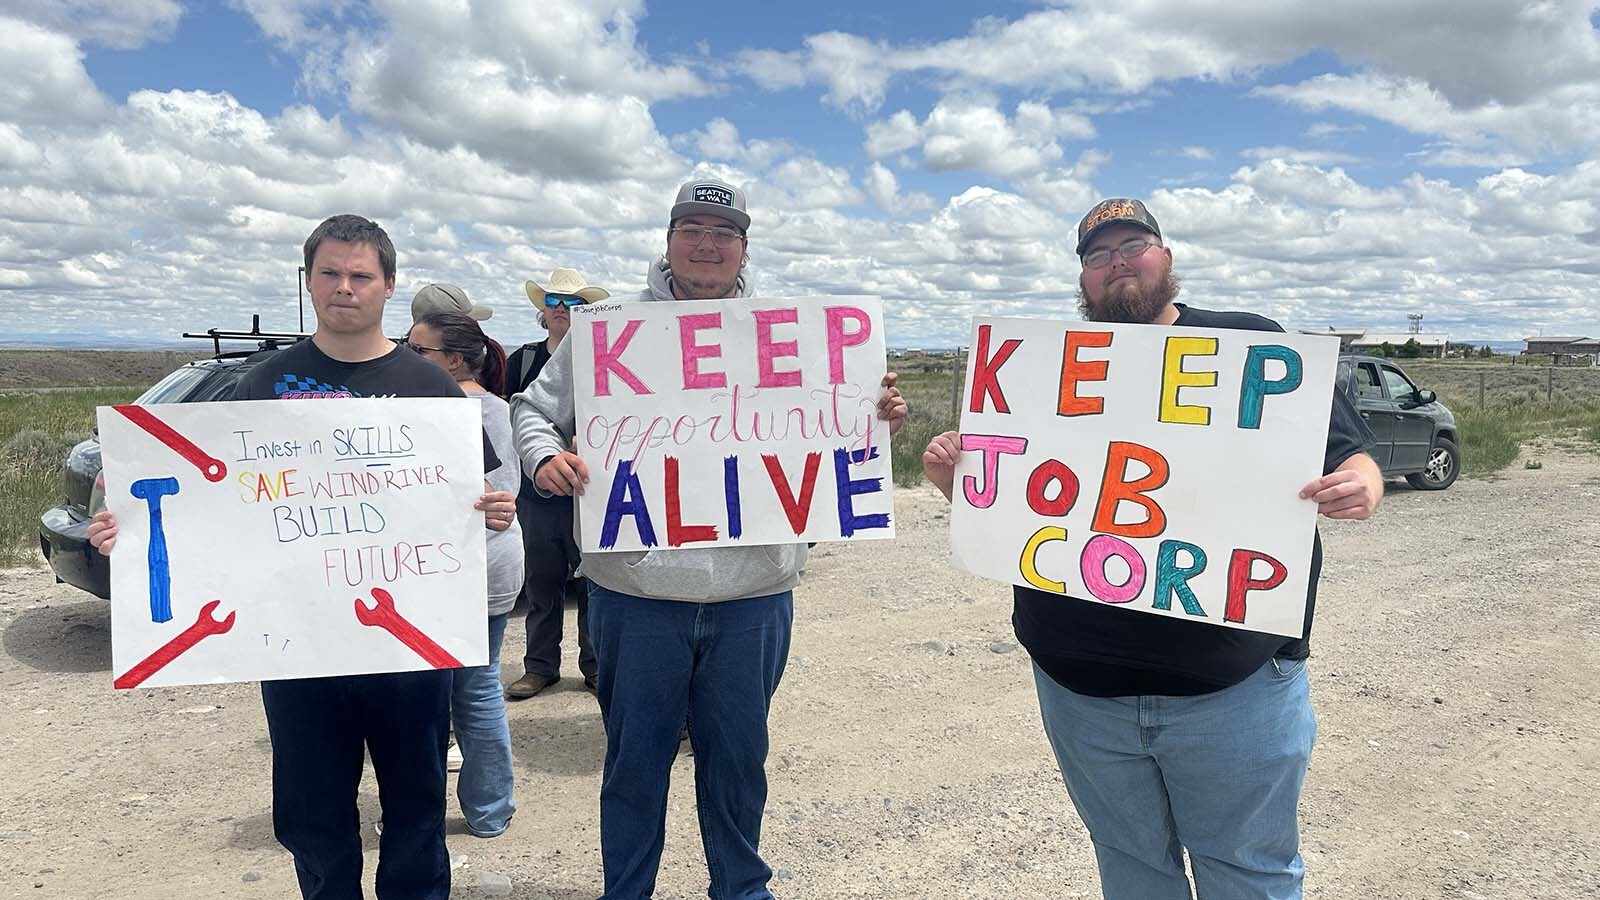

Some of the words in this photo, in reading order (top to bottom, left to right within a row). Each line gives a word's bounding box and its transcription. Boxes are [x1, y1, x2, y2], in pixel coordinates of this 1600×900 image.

[696, 189, 731, 200] SEATTLE
[1087, 207, 1134, 231] STORM
[591, 306, 872, 396] KEEP
[969, 325, 1303, 429] KEEP
[233, 430, 302, 461] Invest
[309, 439, 322, 455] in
[333, 424, 414, 456] SKILLS
[586, 383, 880, 475] opportunity
[238, 469, 304, 504] SAVE
[599, 446, 892, 549] ALIVE
[273, 502, 385, 542] BUILD
[323, 541, 462, 587] FUTURES
[1019, 525, 1288, 624] CORP
